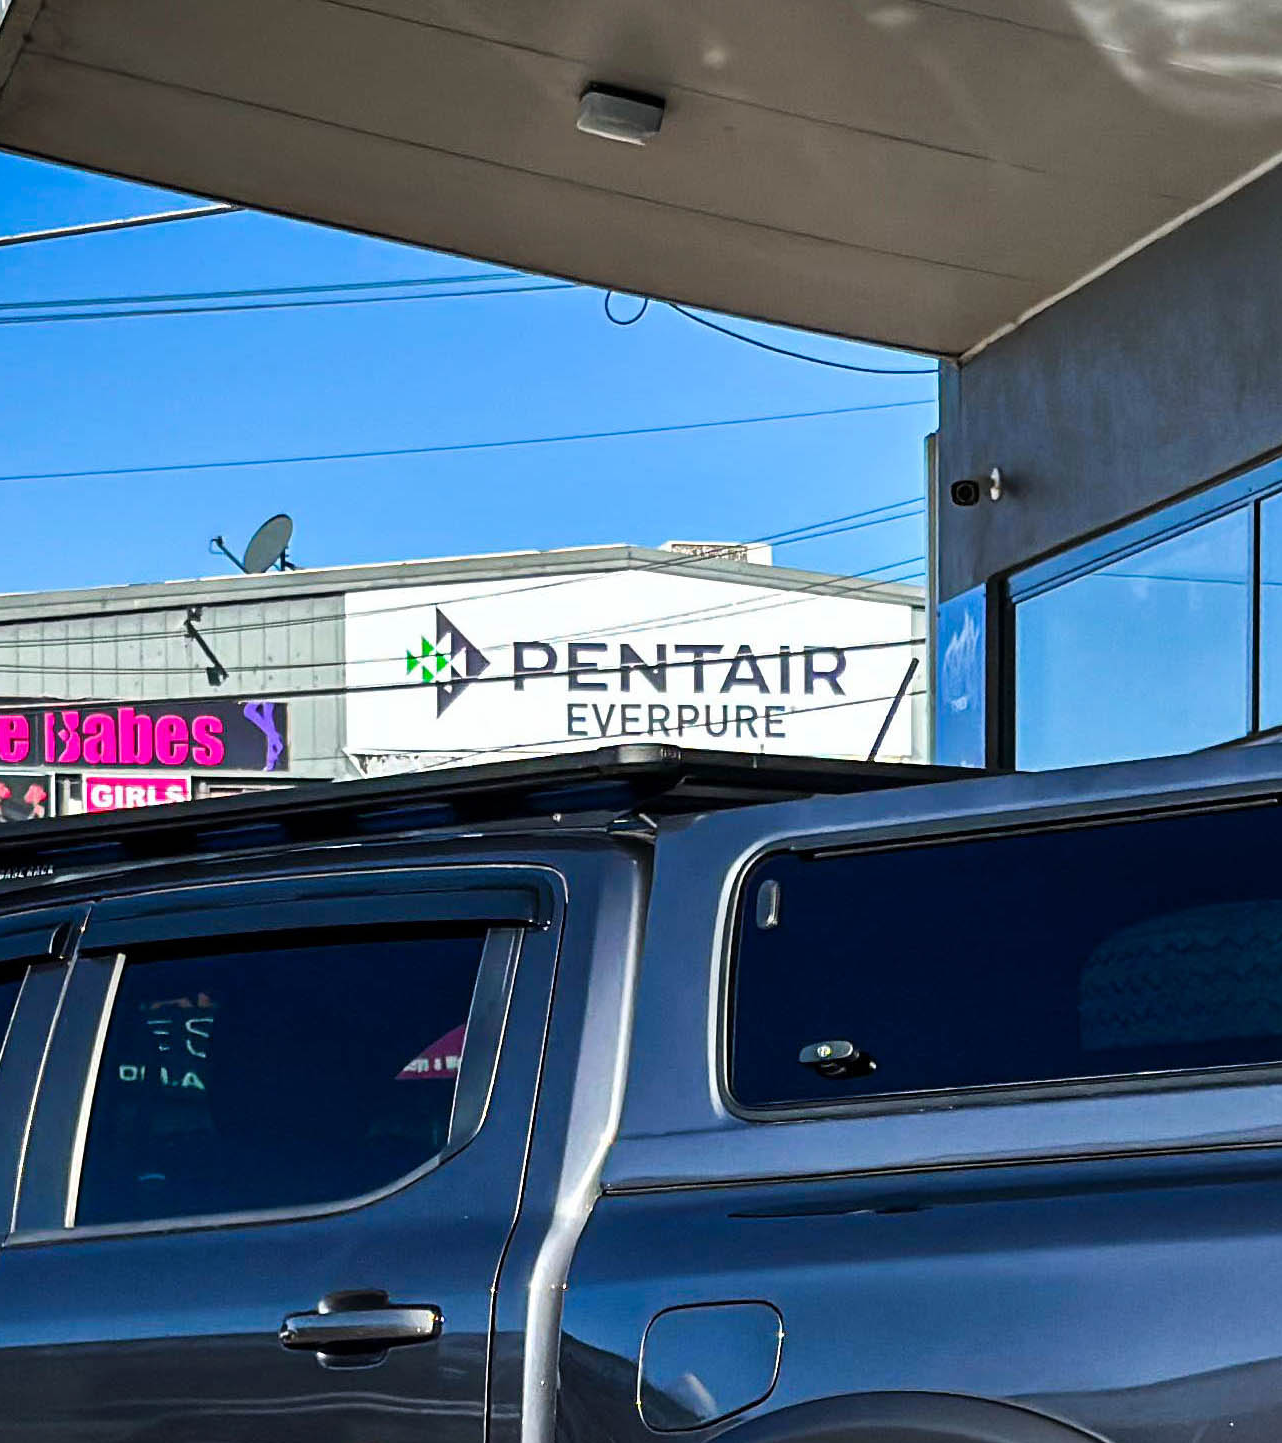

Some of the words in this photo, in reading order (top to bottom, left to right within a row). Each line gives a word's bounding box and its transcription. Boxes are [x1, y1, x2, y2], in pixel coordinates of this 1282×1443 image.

[514, 641, 847, 696] PENTAIR
[44, 706, 225, 767] Babes
[567, 703, 786, 739] EVERPURE
[90, 784, 186, 809] GIRLS
